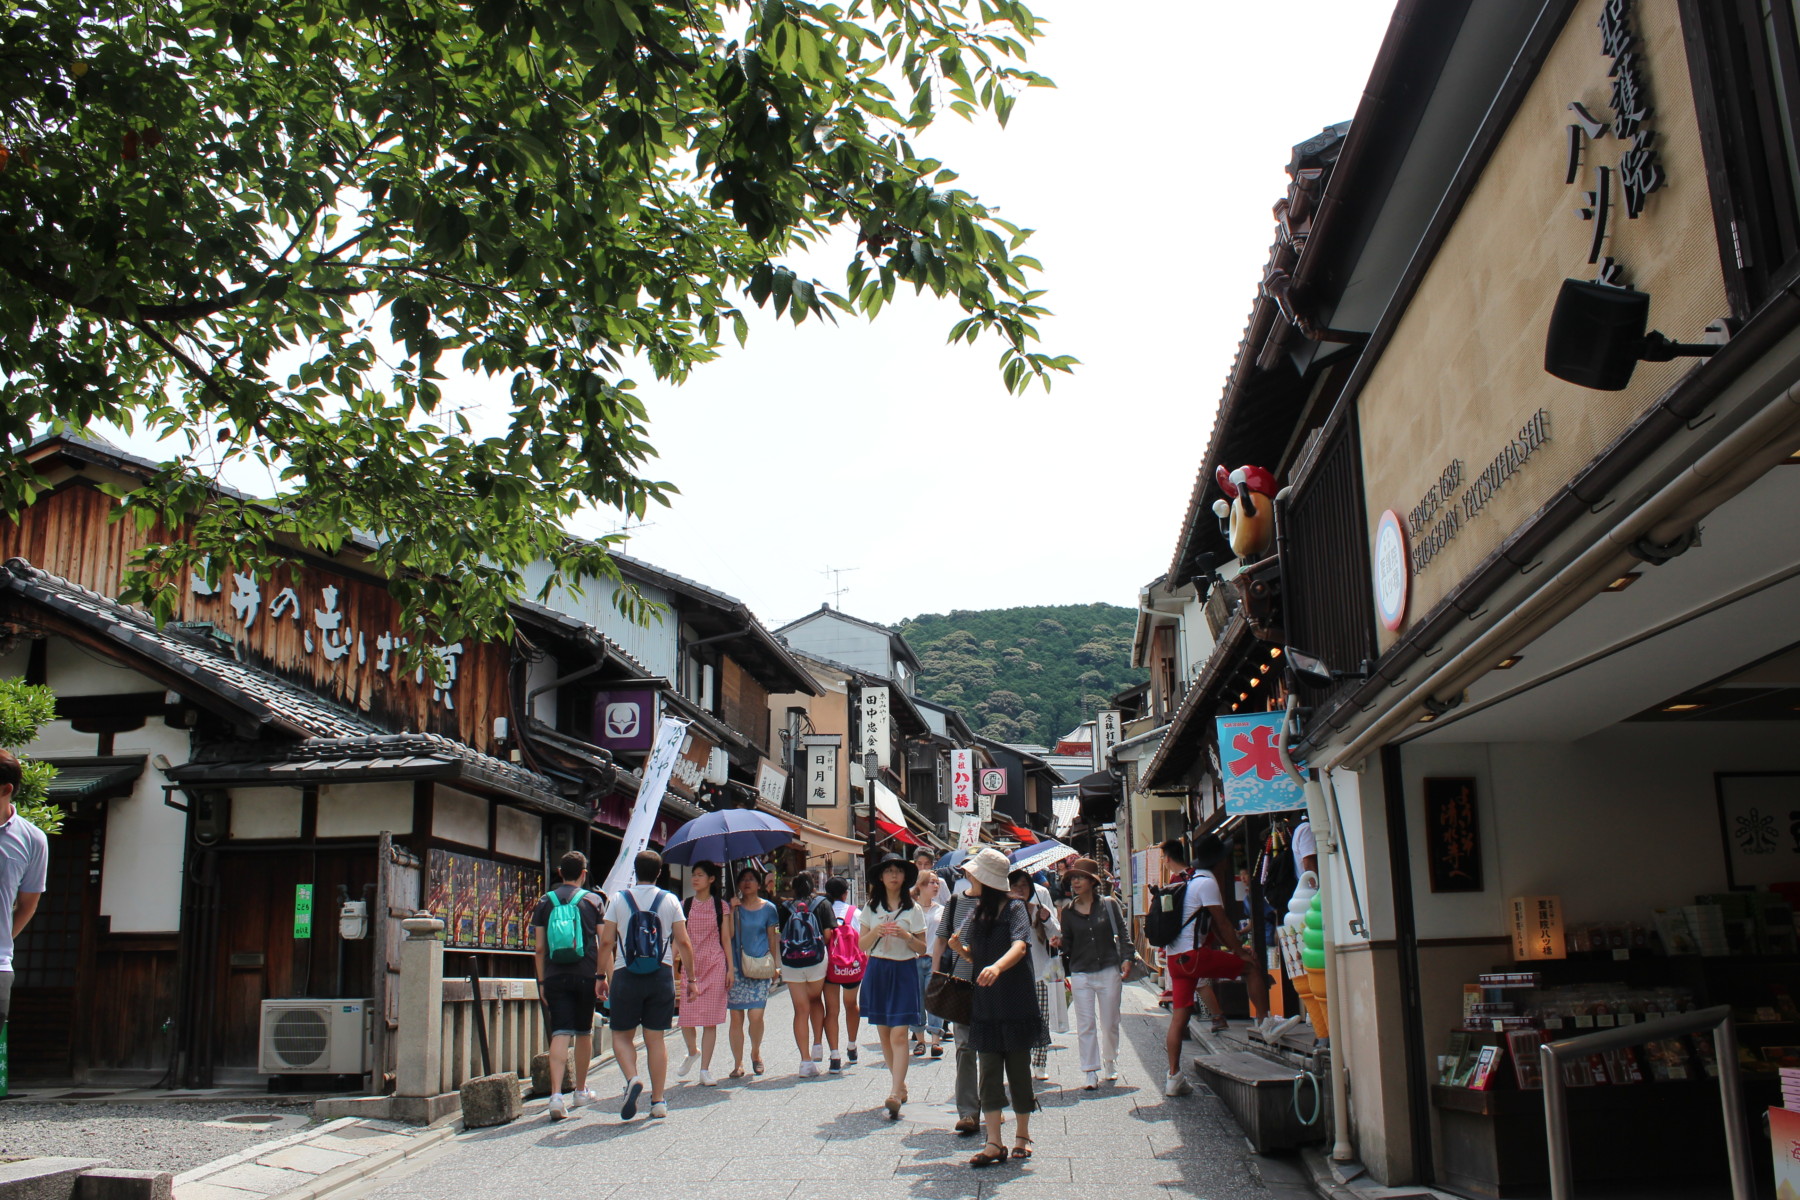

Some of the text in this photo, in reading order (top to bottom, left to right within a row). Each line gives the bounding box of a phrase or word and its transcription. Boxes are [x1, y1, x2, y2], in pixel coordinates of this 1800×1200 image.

[1408, 458, 1464, 540] SINCE 1689
[1411, 407, 1549, 576] SHOGOIN YATSUHASHI
[812, 755, 827, 799] 日月庵
[1228, 725, 1305, 781] 氷
[297, 903, 310, 911] こども
[834, 966, 861, 976] adidas
